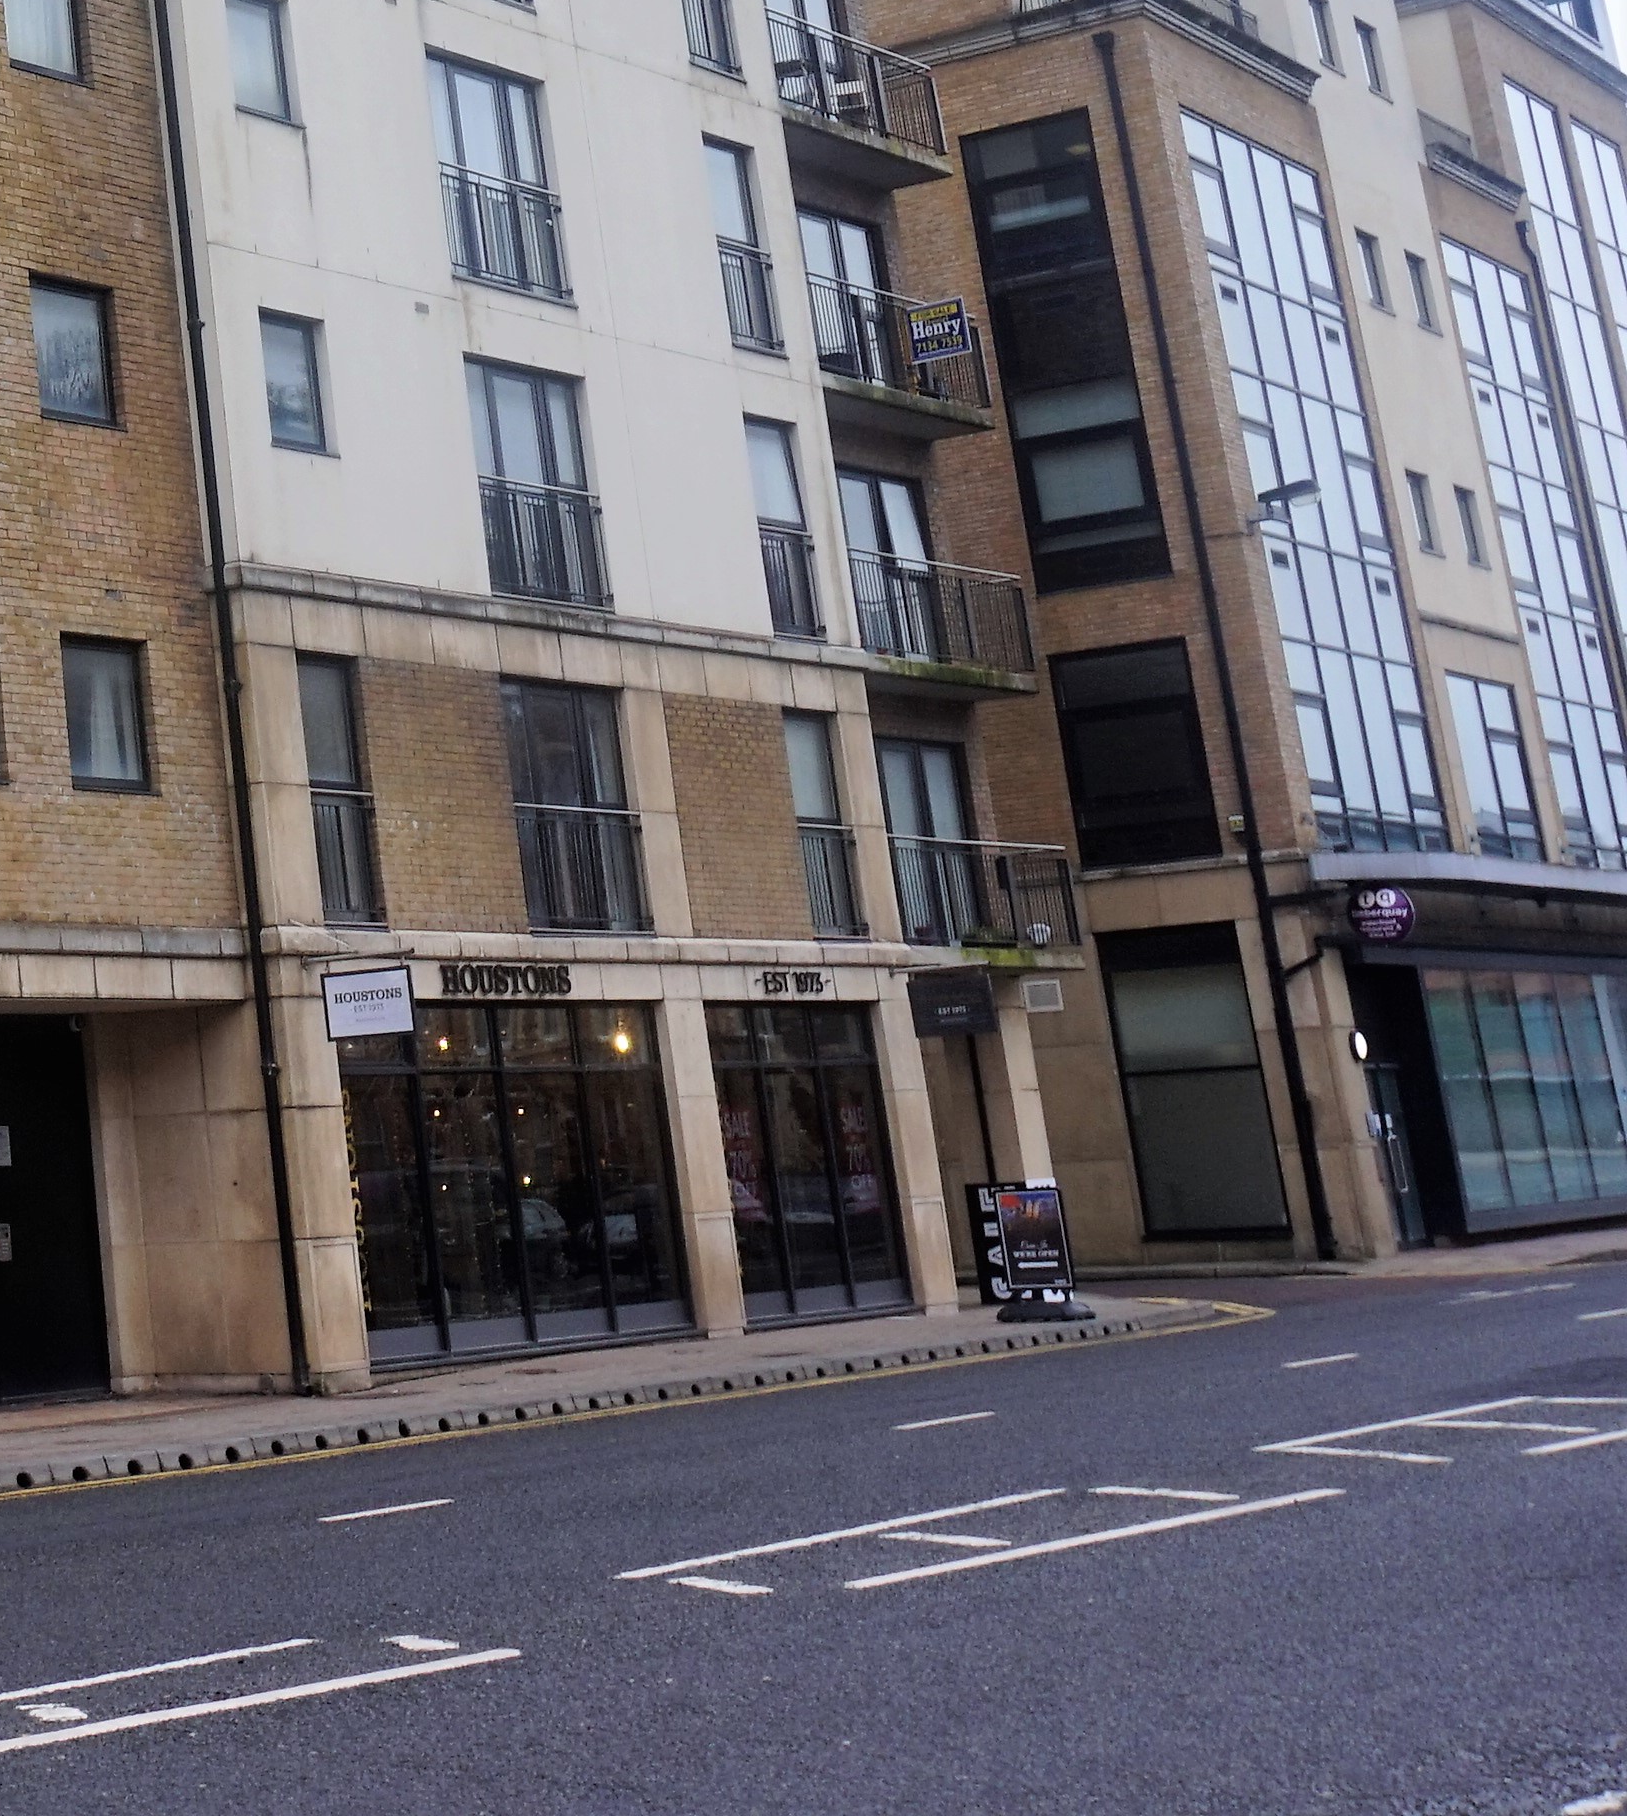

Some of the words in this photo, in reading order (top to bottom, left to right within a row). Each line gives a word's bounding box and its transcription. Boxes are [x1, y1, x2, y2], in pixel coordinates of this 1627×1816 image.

[911, 318, 961, 339] Henry
[439, 963, 572, 996] HOUSTONS
[334, 987, 403, 1004] HOUSTONS
